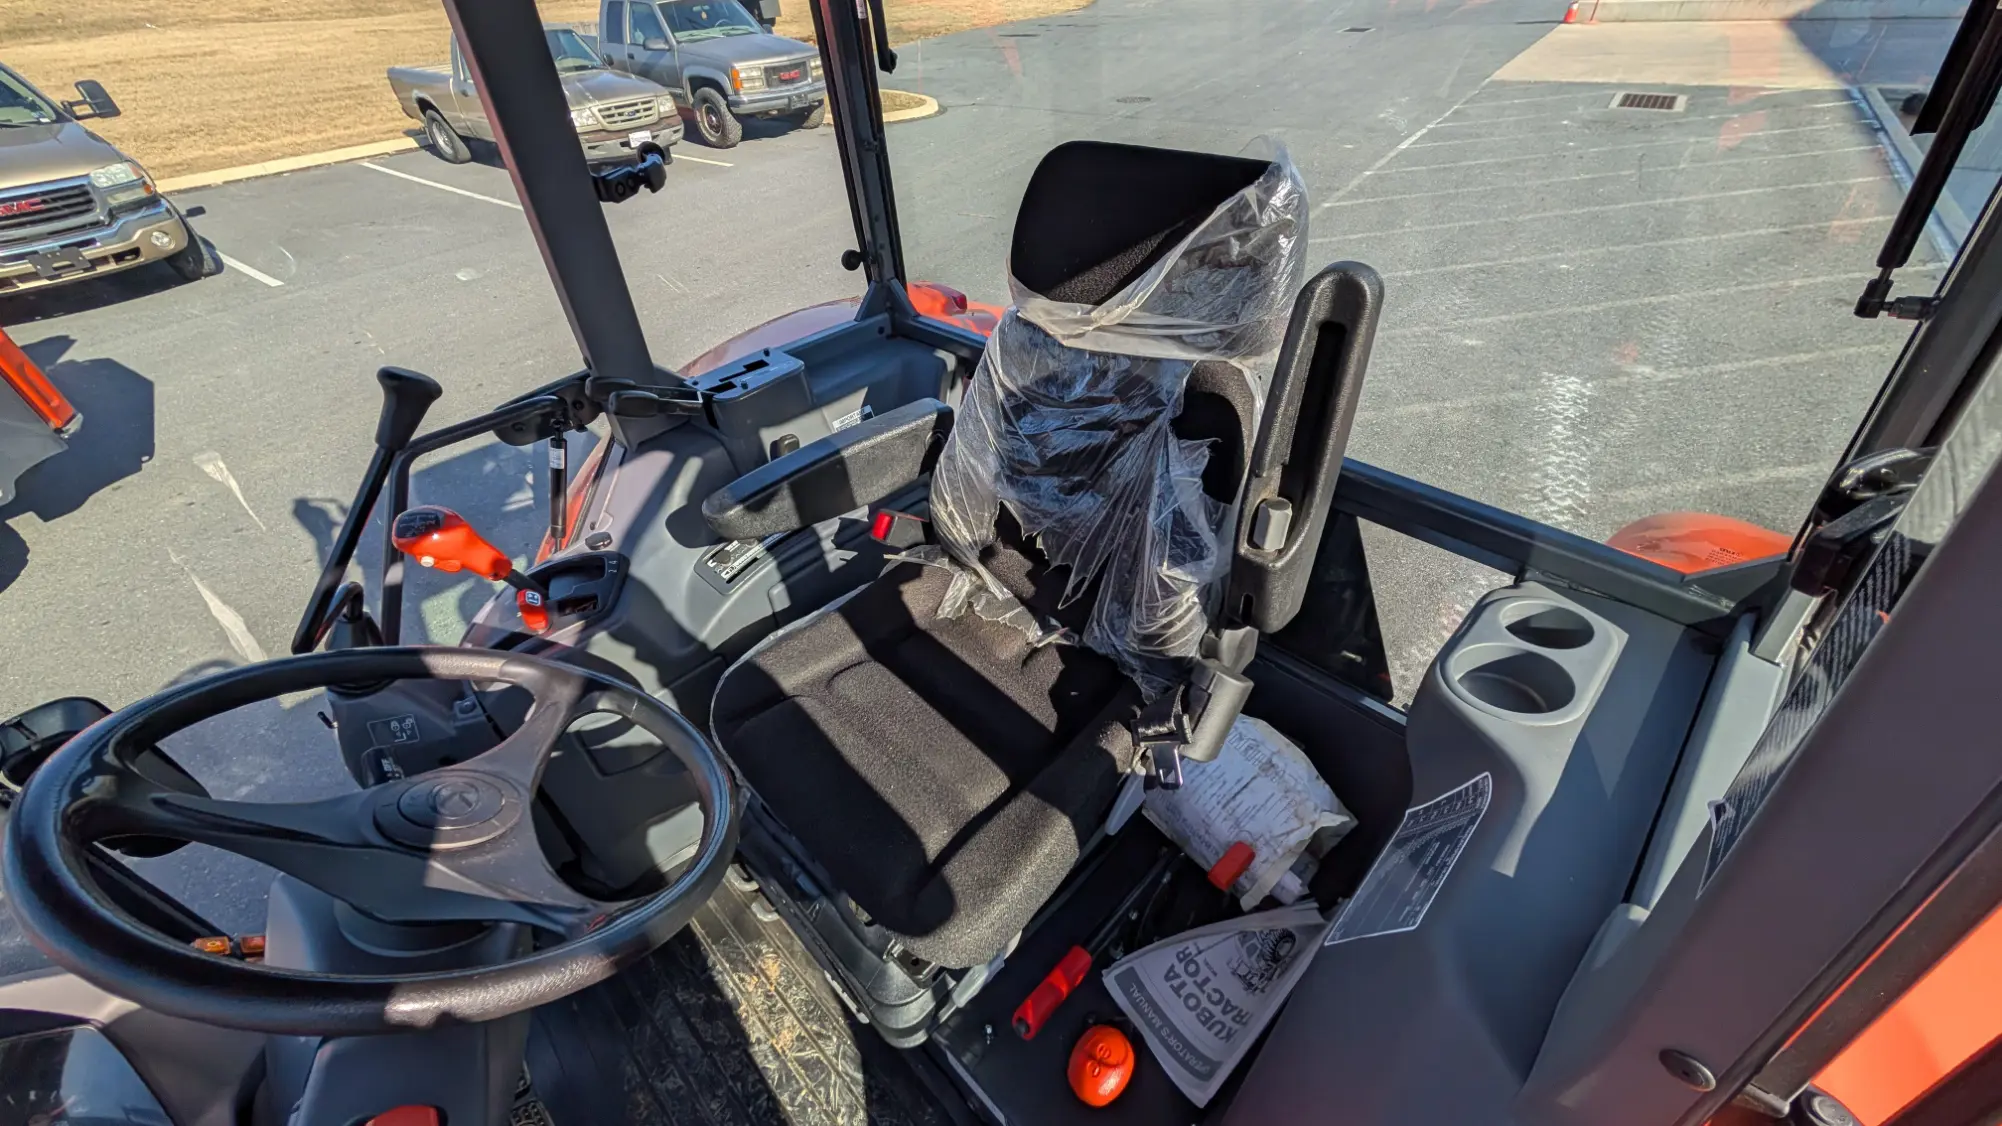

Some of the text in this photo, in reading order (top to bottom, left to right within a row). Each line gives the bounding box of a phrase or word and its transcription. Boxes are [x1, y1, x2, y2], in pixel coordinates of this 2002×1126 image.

[0, 198, 44, 216] MC
[1129, 982, 1162, 1027] MANUAL
[1163, 963, 1239, 1043] KUBOTA
